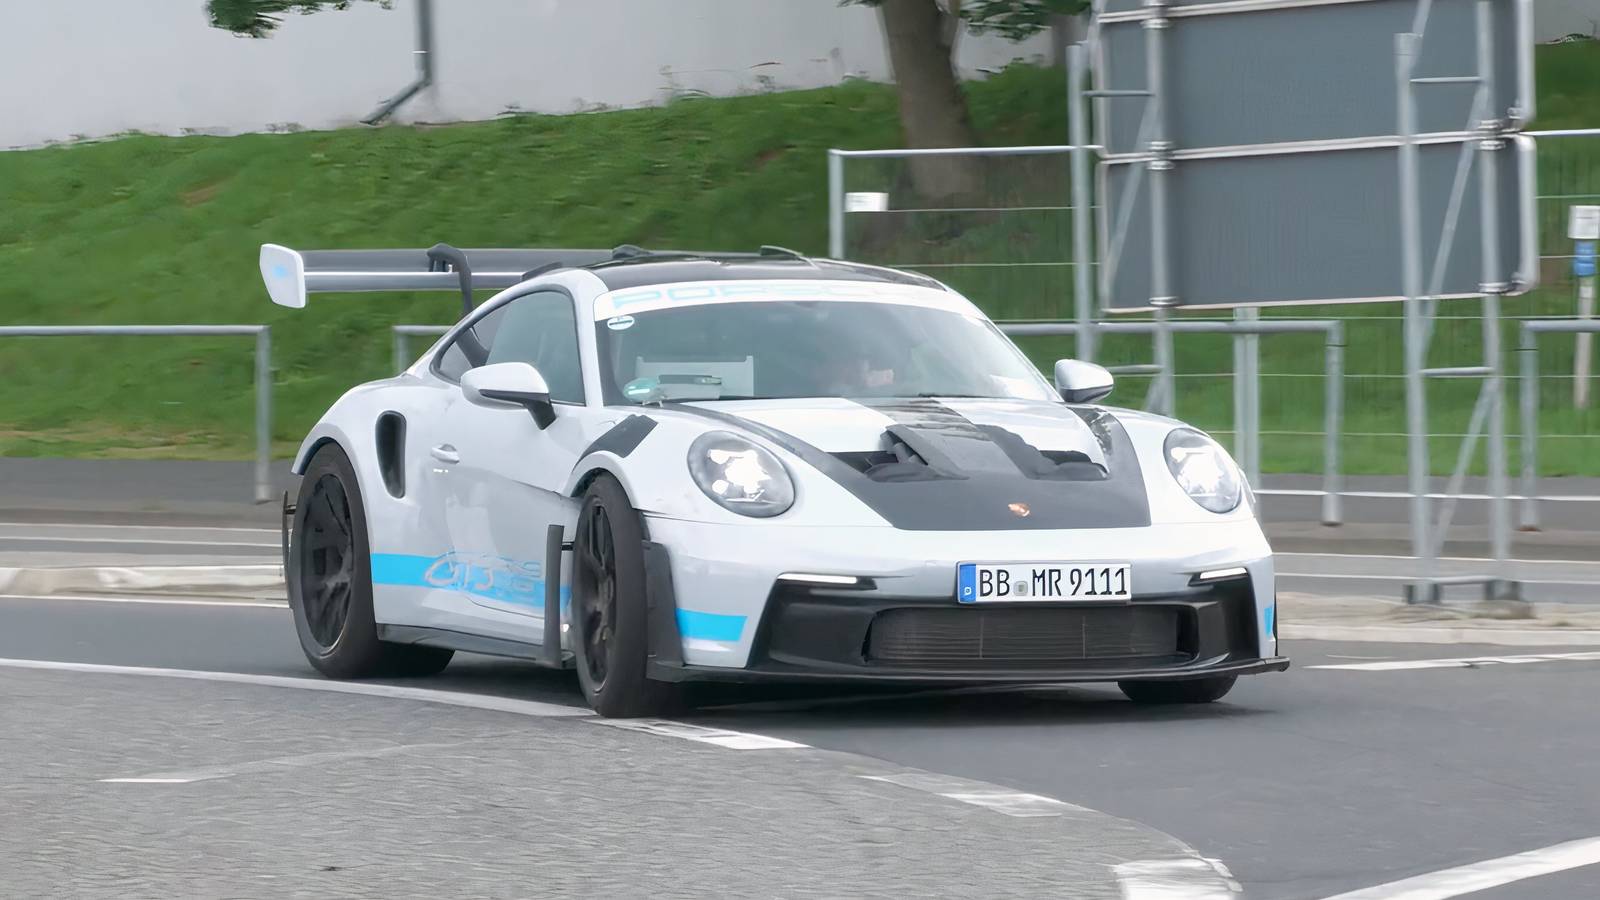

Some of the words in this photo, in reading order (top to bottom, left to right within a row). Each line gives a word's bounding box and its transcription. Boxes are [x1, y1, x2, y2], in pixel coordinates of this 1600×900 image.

[979, 569, 1010, 597] BB
[1032, 569, 1062, 597] MR
[1070, 568, 1127, 596] 9111
